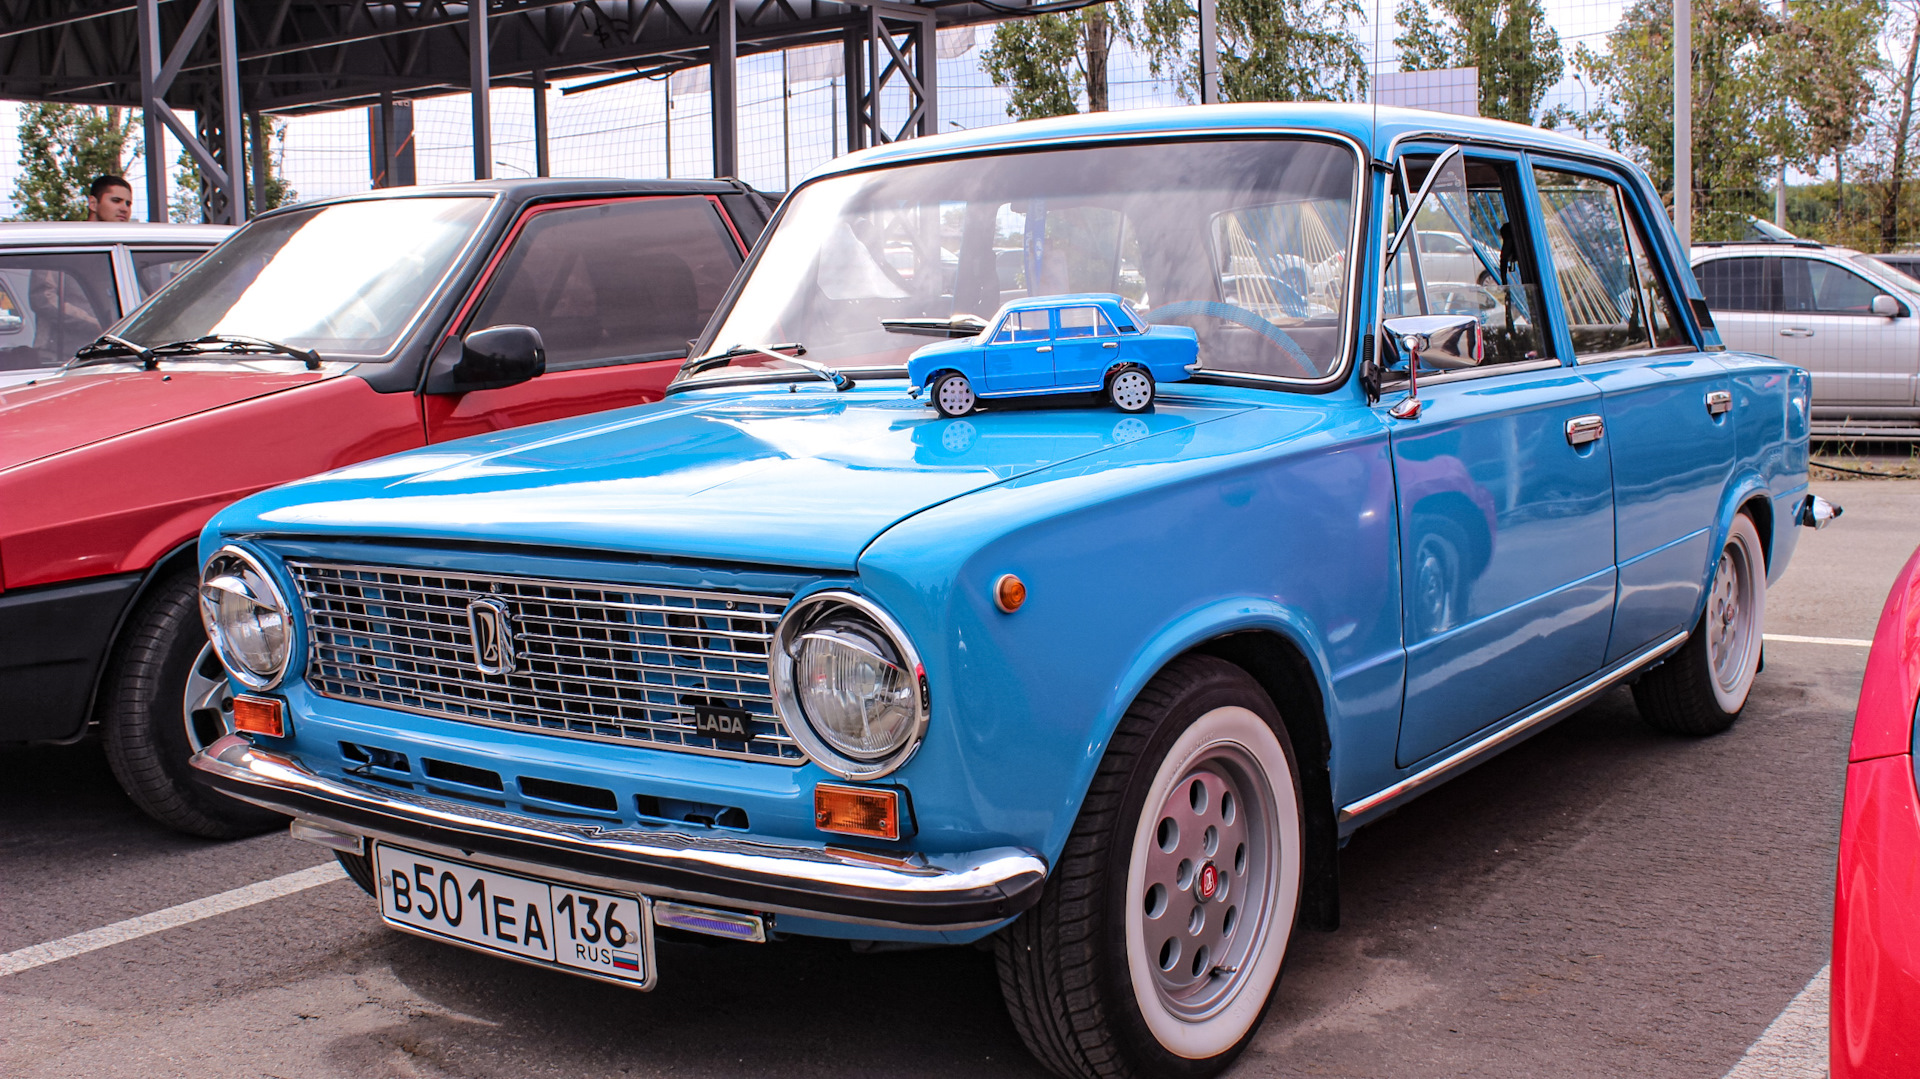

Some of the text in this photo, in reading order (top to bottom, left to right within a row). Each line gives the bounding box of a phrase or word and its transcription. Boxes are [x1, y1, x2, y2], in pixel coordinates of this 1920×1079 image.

[696, 713, 744, 734] LADA
[392, 863, 627, 950] B501EA 136
[576, 943, 611, 964] RUS
